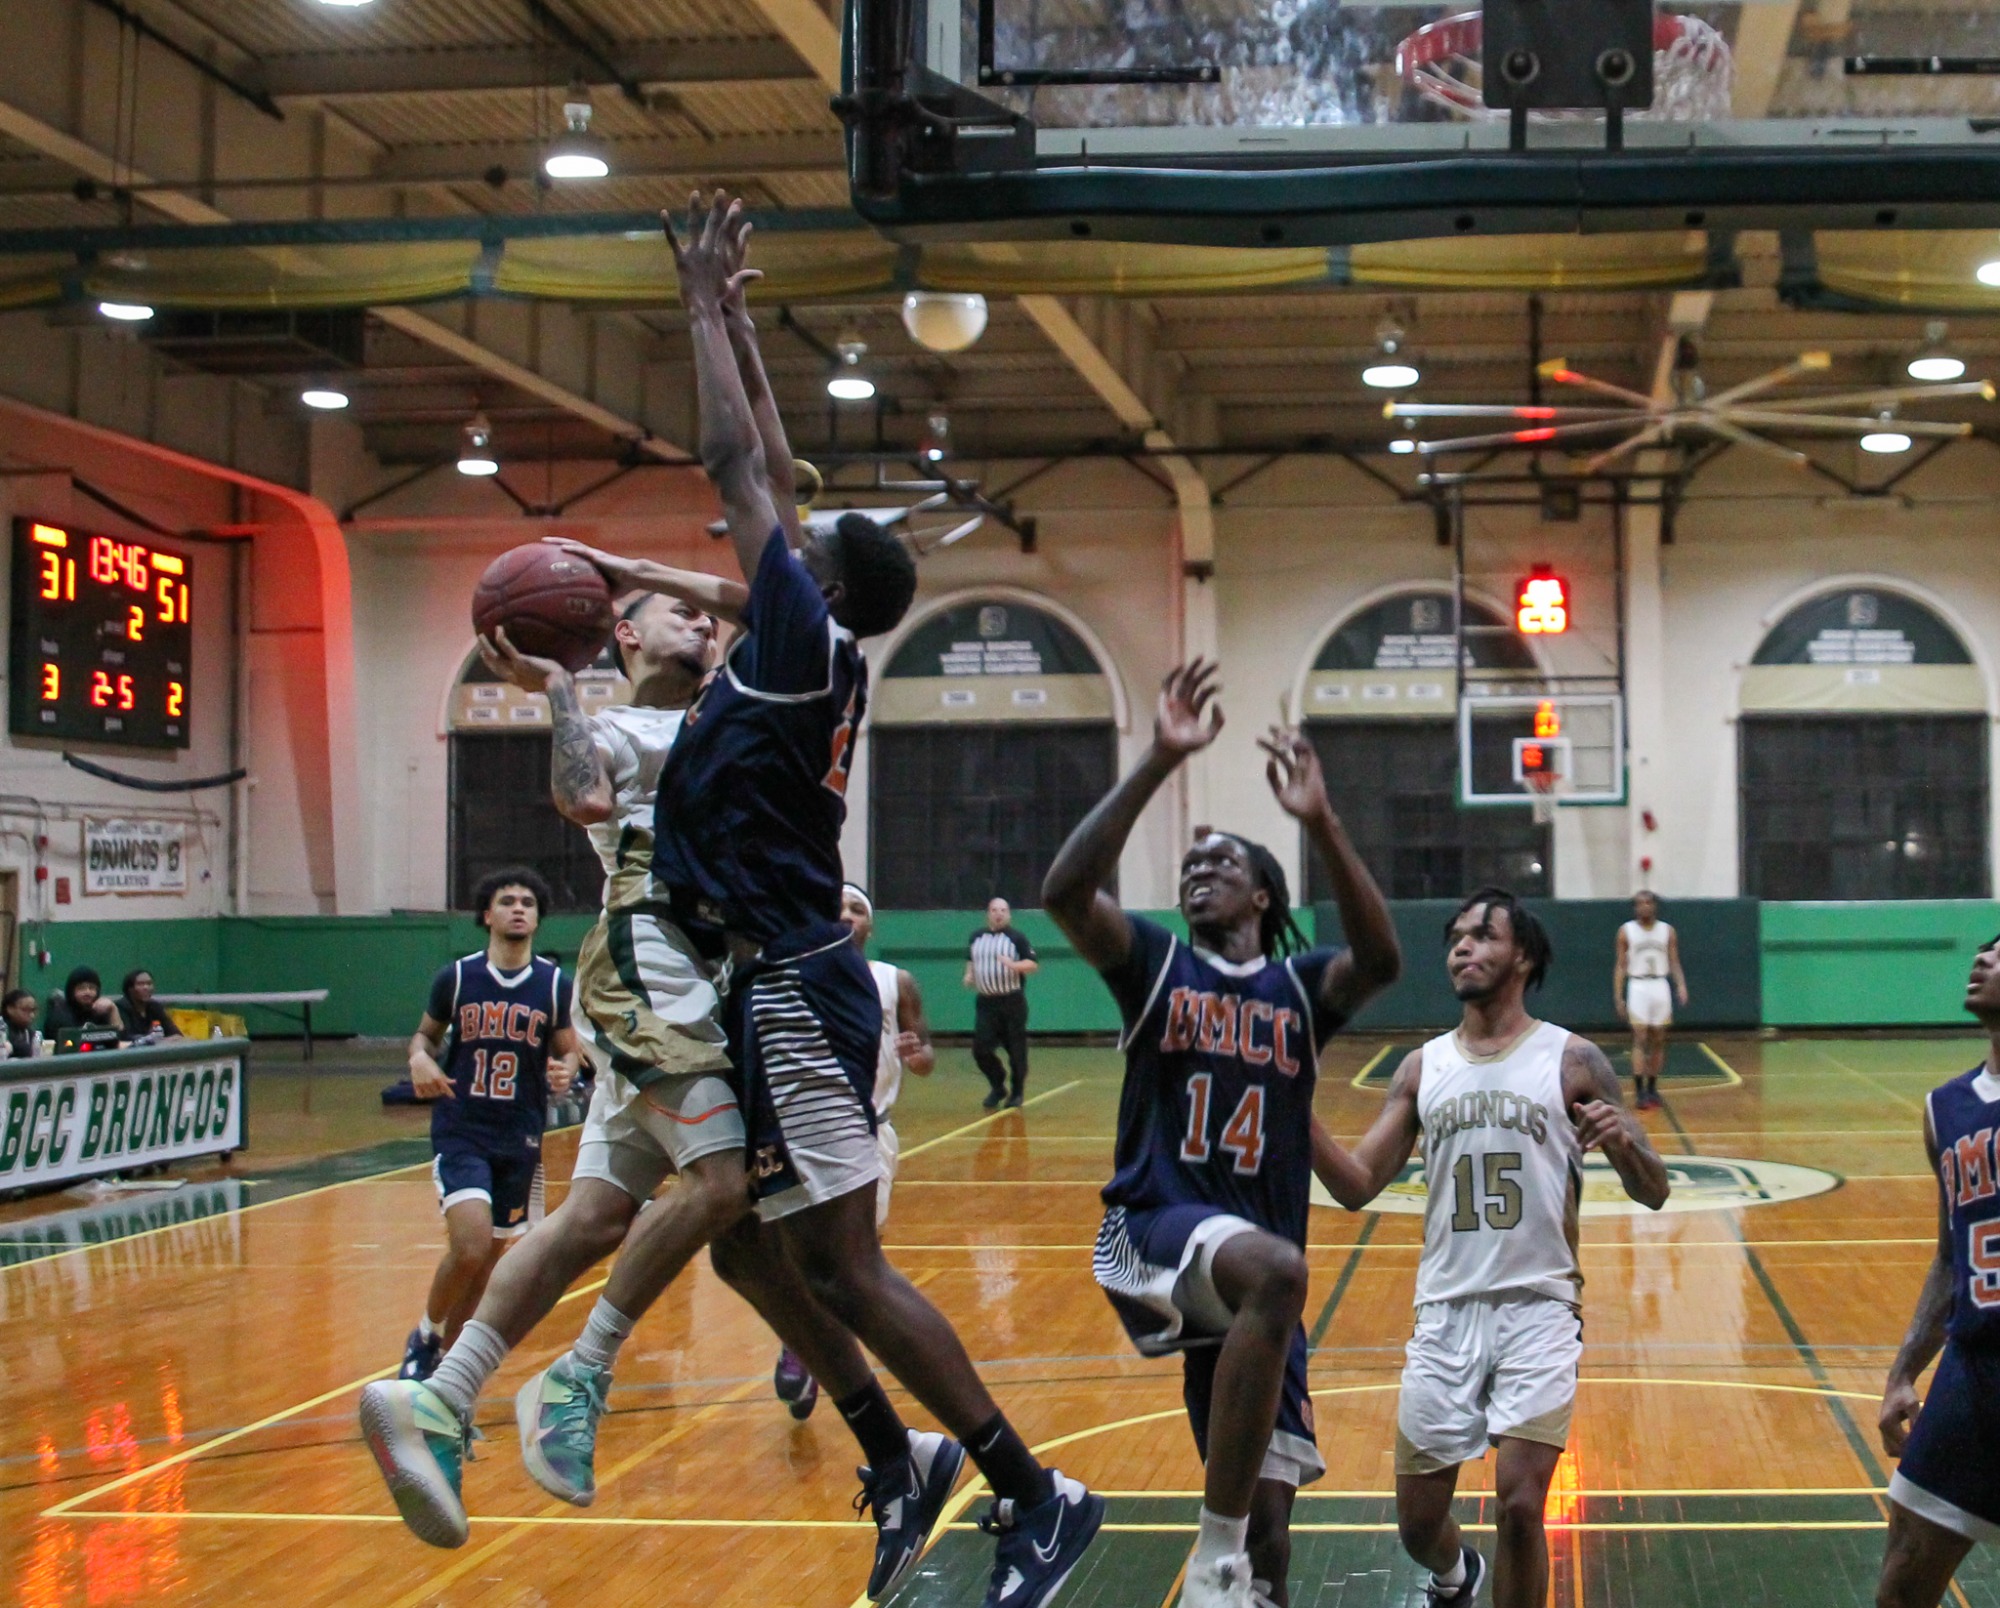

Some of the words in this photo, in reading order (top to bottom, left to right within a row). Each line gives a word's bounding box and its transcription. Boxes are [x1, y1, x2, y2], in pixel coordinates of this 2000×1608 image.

[41, 551, 76, 601] 31
[90, 537, 147, 591] 13:46
[129, 606, 144, 641] 2
[158, 577, 188, 623] 51
[42, 663, 59, 700] 3
[168, 682, 183, 716] 2
[460, 1001, 547, 1047] BMCC
[1160, 985, 1300, 1078] BMCC
[470, 1048, 518, 1099] 12
[0, 1082, 77, 1175] BCC
[78, 1060, 235, 1162] BRONCOS
[1180, 1072, 1266, 1175] 14
[1428, 1089, 1548, 1153] BRONCOS
[1452, 1152, 1523, 1232] 15
